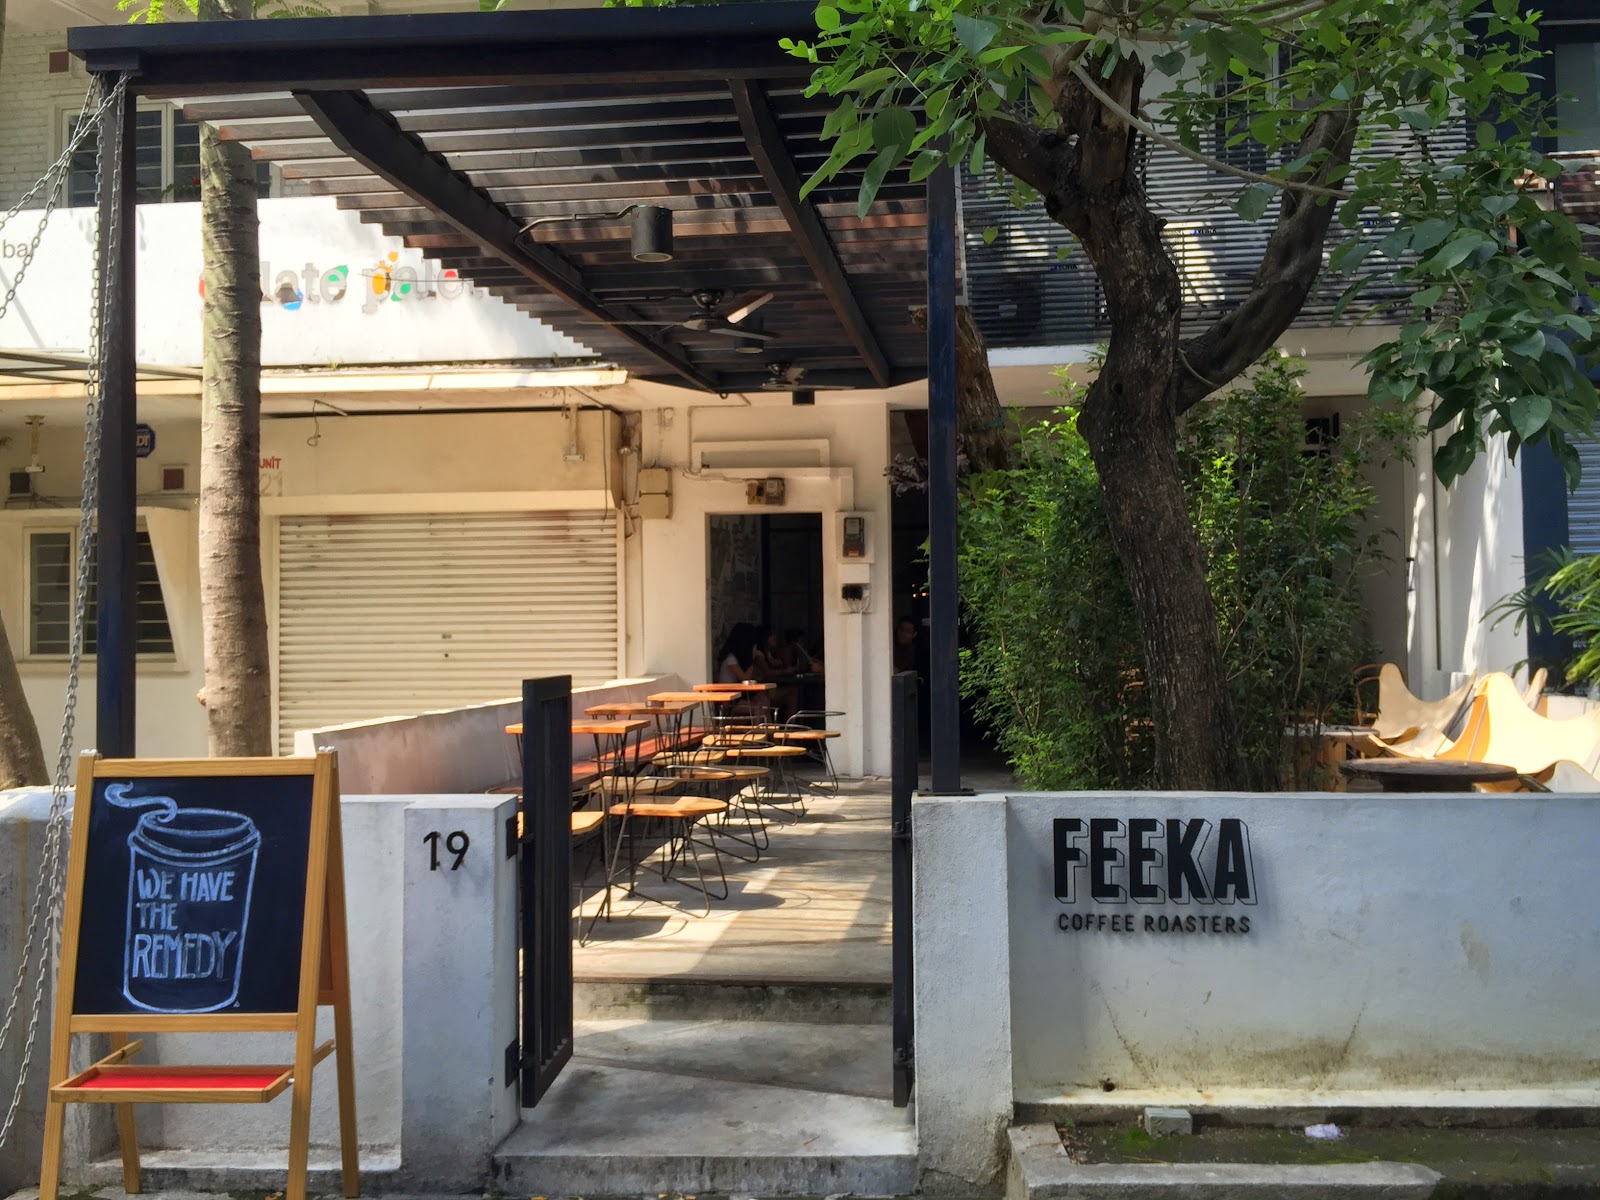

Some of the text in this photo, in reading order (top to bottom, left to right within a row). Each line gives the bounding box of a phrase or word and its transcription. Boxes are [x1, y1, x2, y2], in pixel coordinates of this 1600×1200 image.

[423, 830, 470, 871] 19
[1053, 818, 1258, 905] FEEKA
[137, 867, 235, 902] WE HAVE
[135, 902, 178, 931] THE
[1058, 913, 1251, 934] COFFEE ROASTERS
[132, 930, 238, 980] REMEDY
